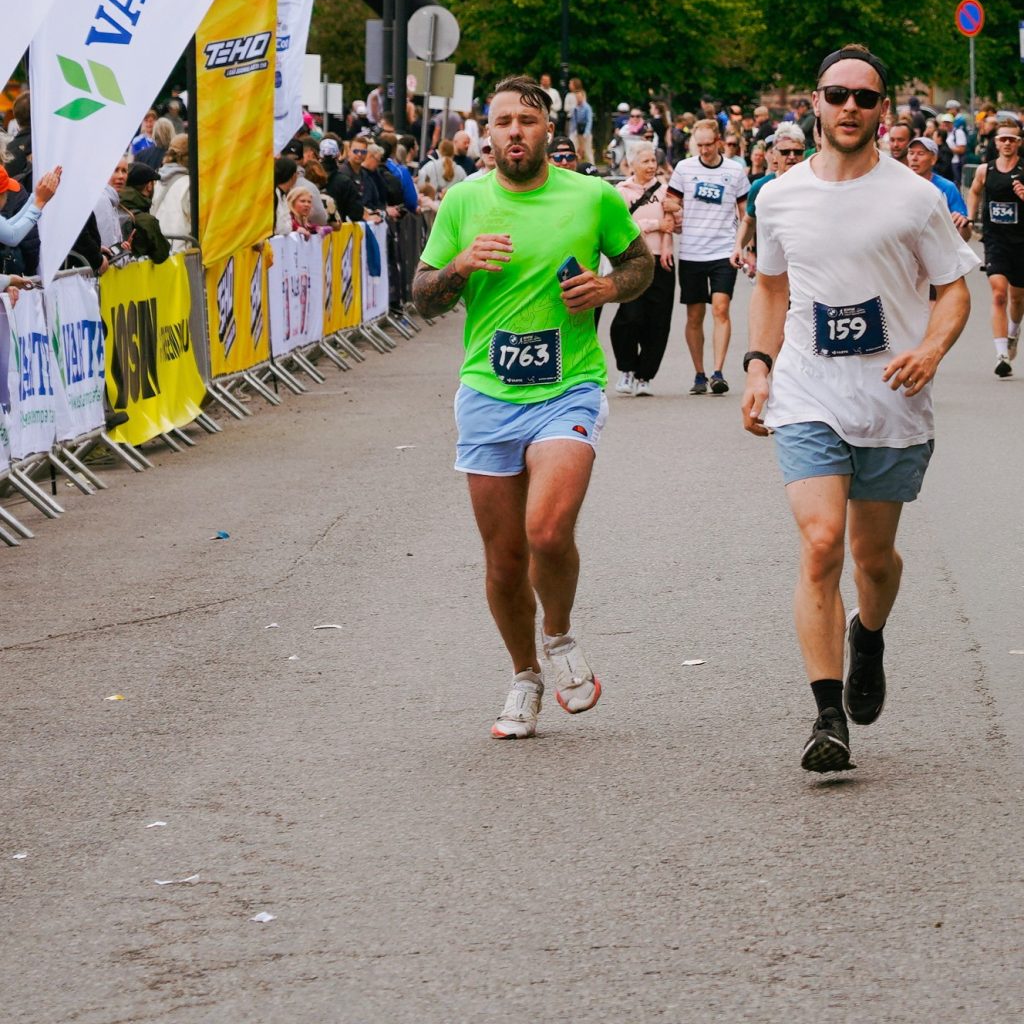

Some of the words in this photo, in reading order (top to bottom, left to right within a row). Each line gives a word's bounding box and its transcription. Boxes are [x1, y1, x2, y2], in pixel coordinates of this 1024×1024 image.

[204, 32, 272, 69] TEHO
[827, 316, 867, 341] 159
[499, 344, 550, 370] 1763
